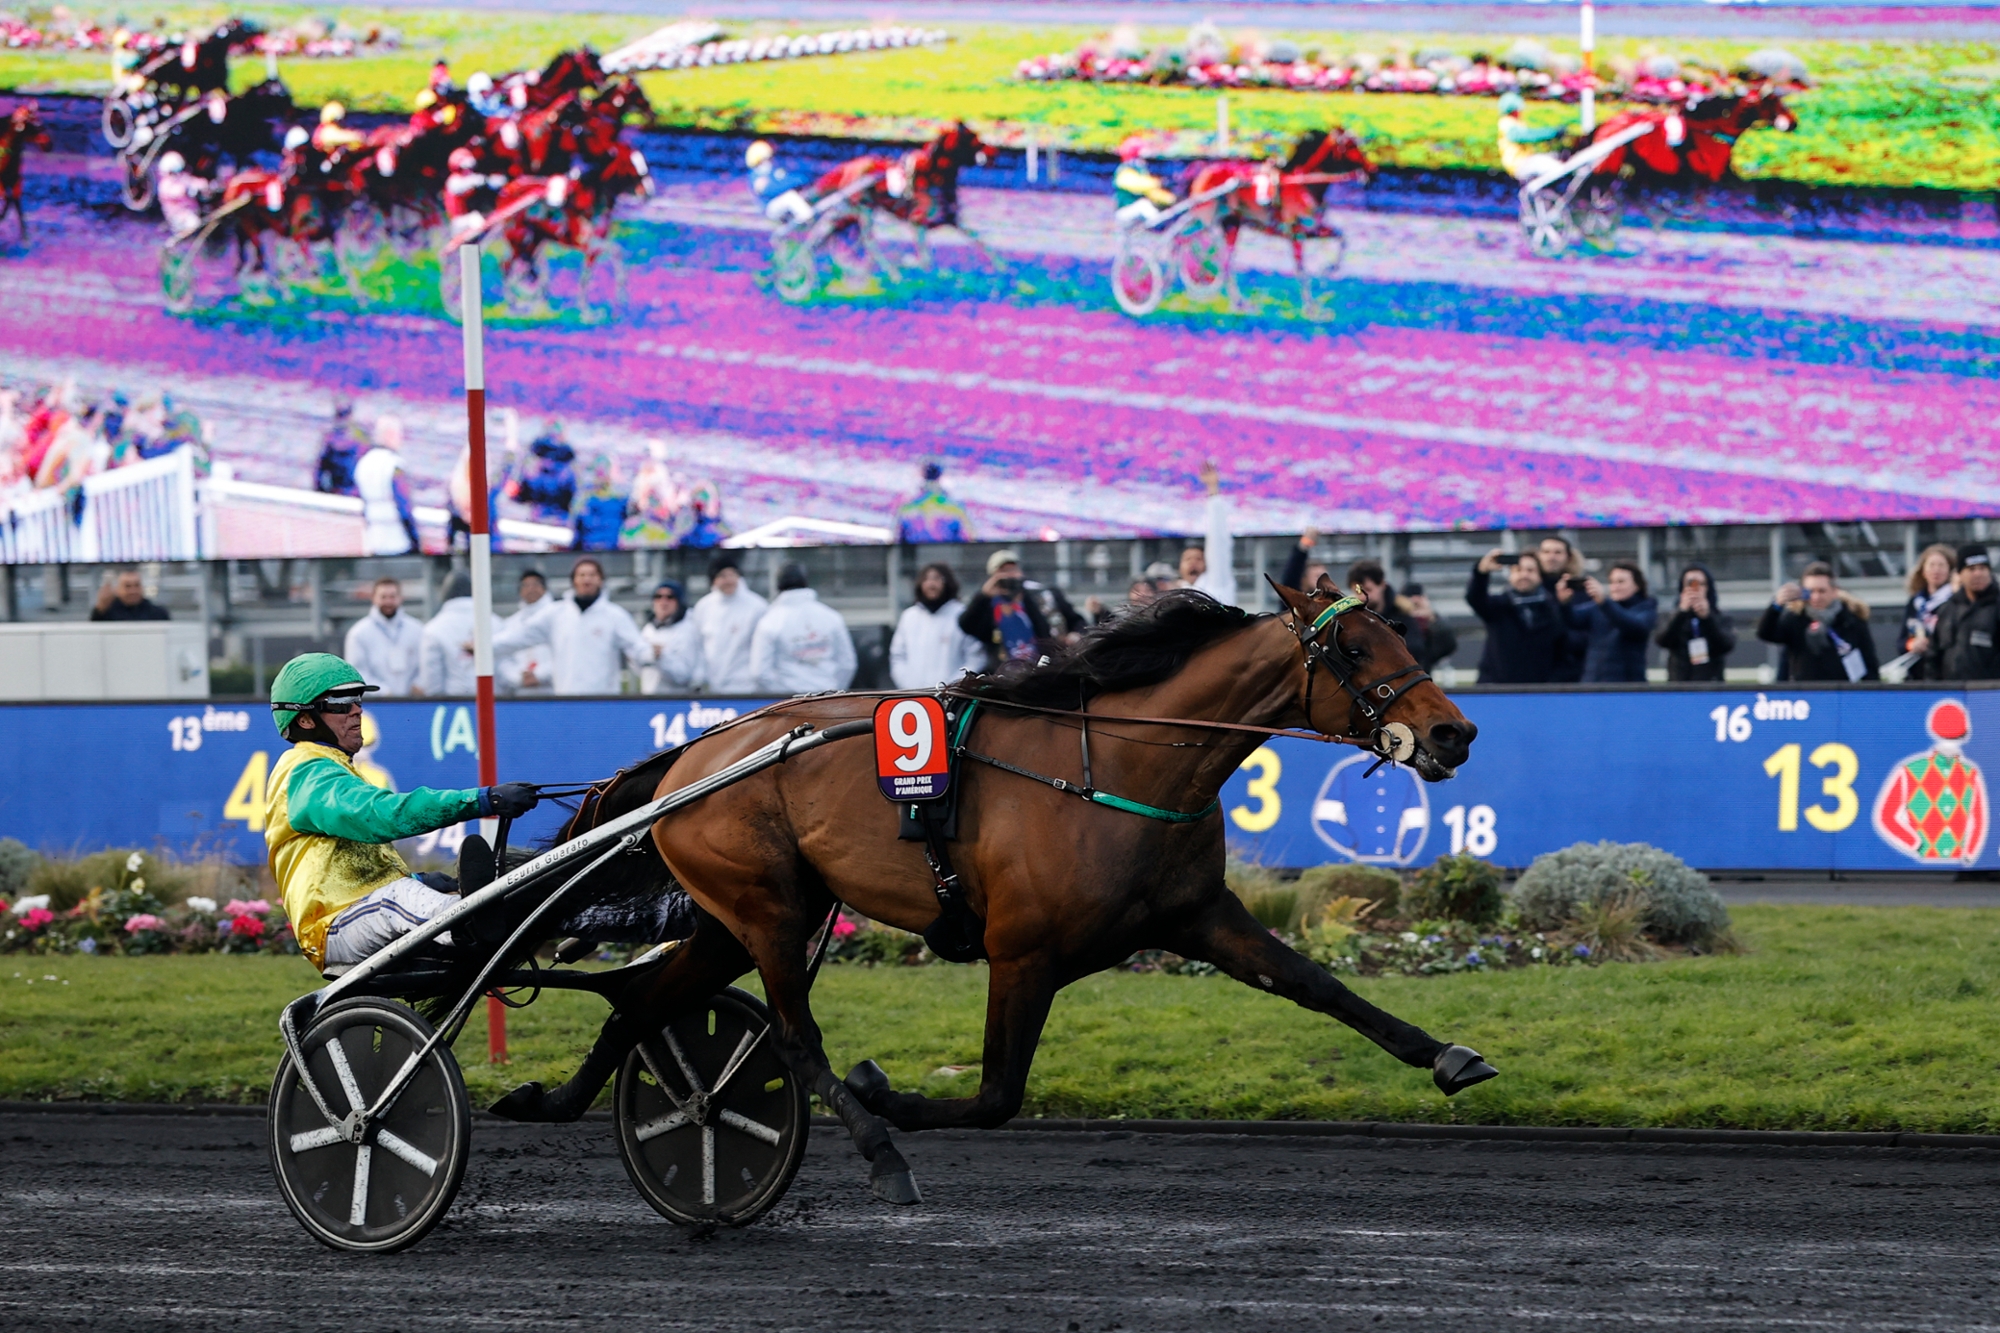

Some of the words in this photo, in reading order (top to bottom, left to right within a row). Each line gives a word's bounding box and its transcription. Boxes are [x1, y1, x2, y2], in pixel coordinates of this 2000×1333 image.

[431, 704, 480, 761] (A
[889, 700, 933, 772] 9
[223, 750, 268, 832] 4
[894, 777, 916, 786] GRAND
[916, 775, 932, 785] PRIX
[1762, 742, 1860, 833] 13
[544, 838, 589, 865] Guarato
[1442, 804, 1498, 857] 18
